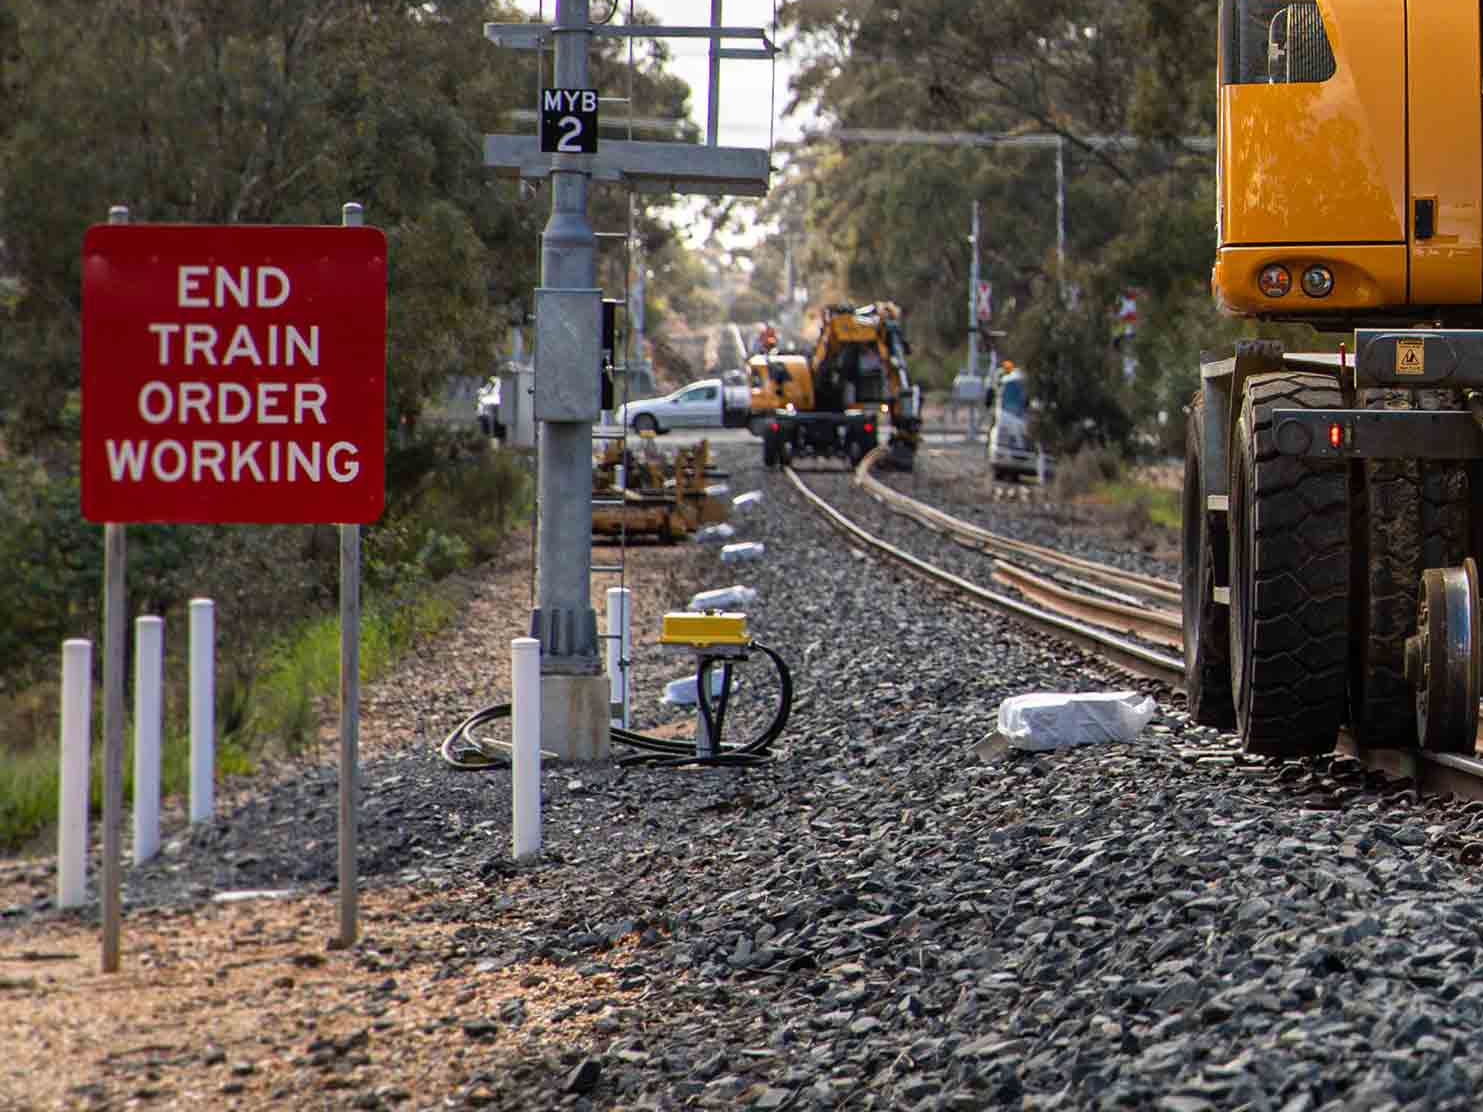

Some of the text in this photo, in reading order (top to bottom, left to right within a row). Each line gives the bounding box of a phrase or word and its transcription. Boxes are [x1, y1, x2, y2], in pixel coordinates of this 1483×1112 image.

[544, 90, 597, 112] MYB
[557, 116, 582, 152] 2
[177, 265, 291, 308] END
[148, 323, 320, 366] TRAIN
[137, 381, 328, 425] ORDER
[105, 439, 360, 483] WORKING
